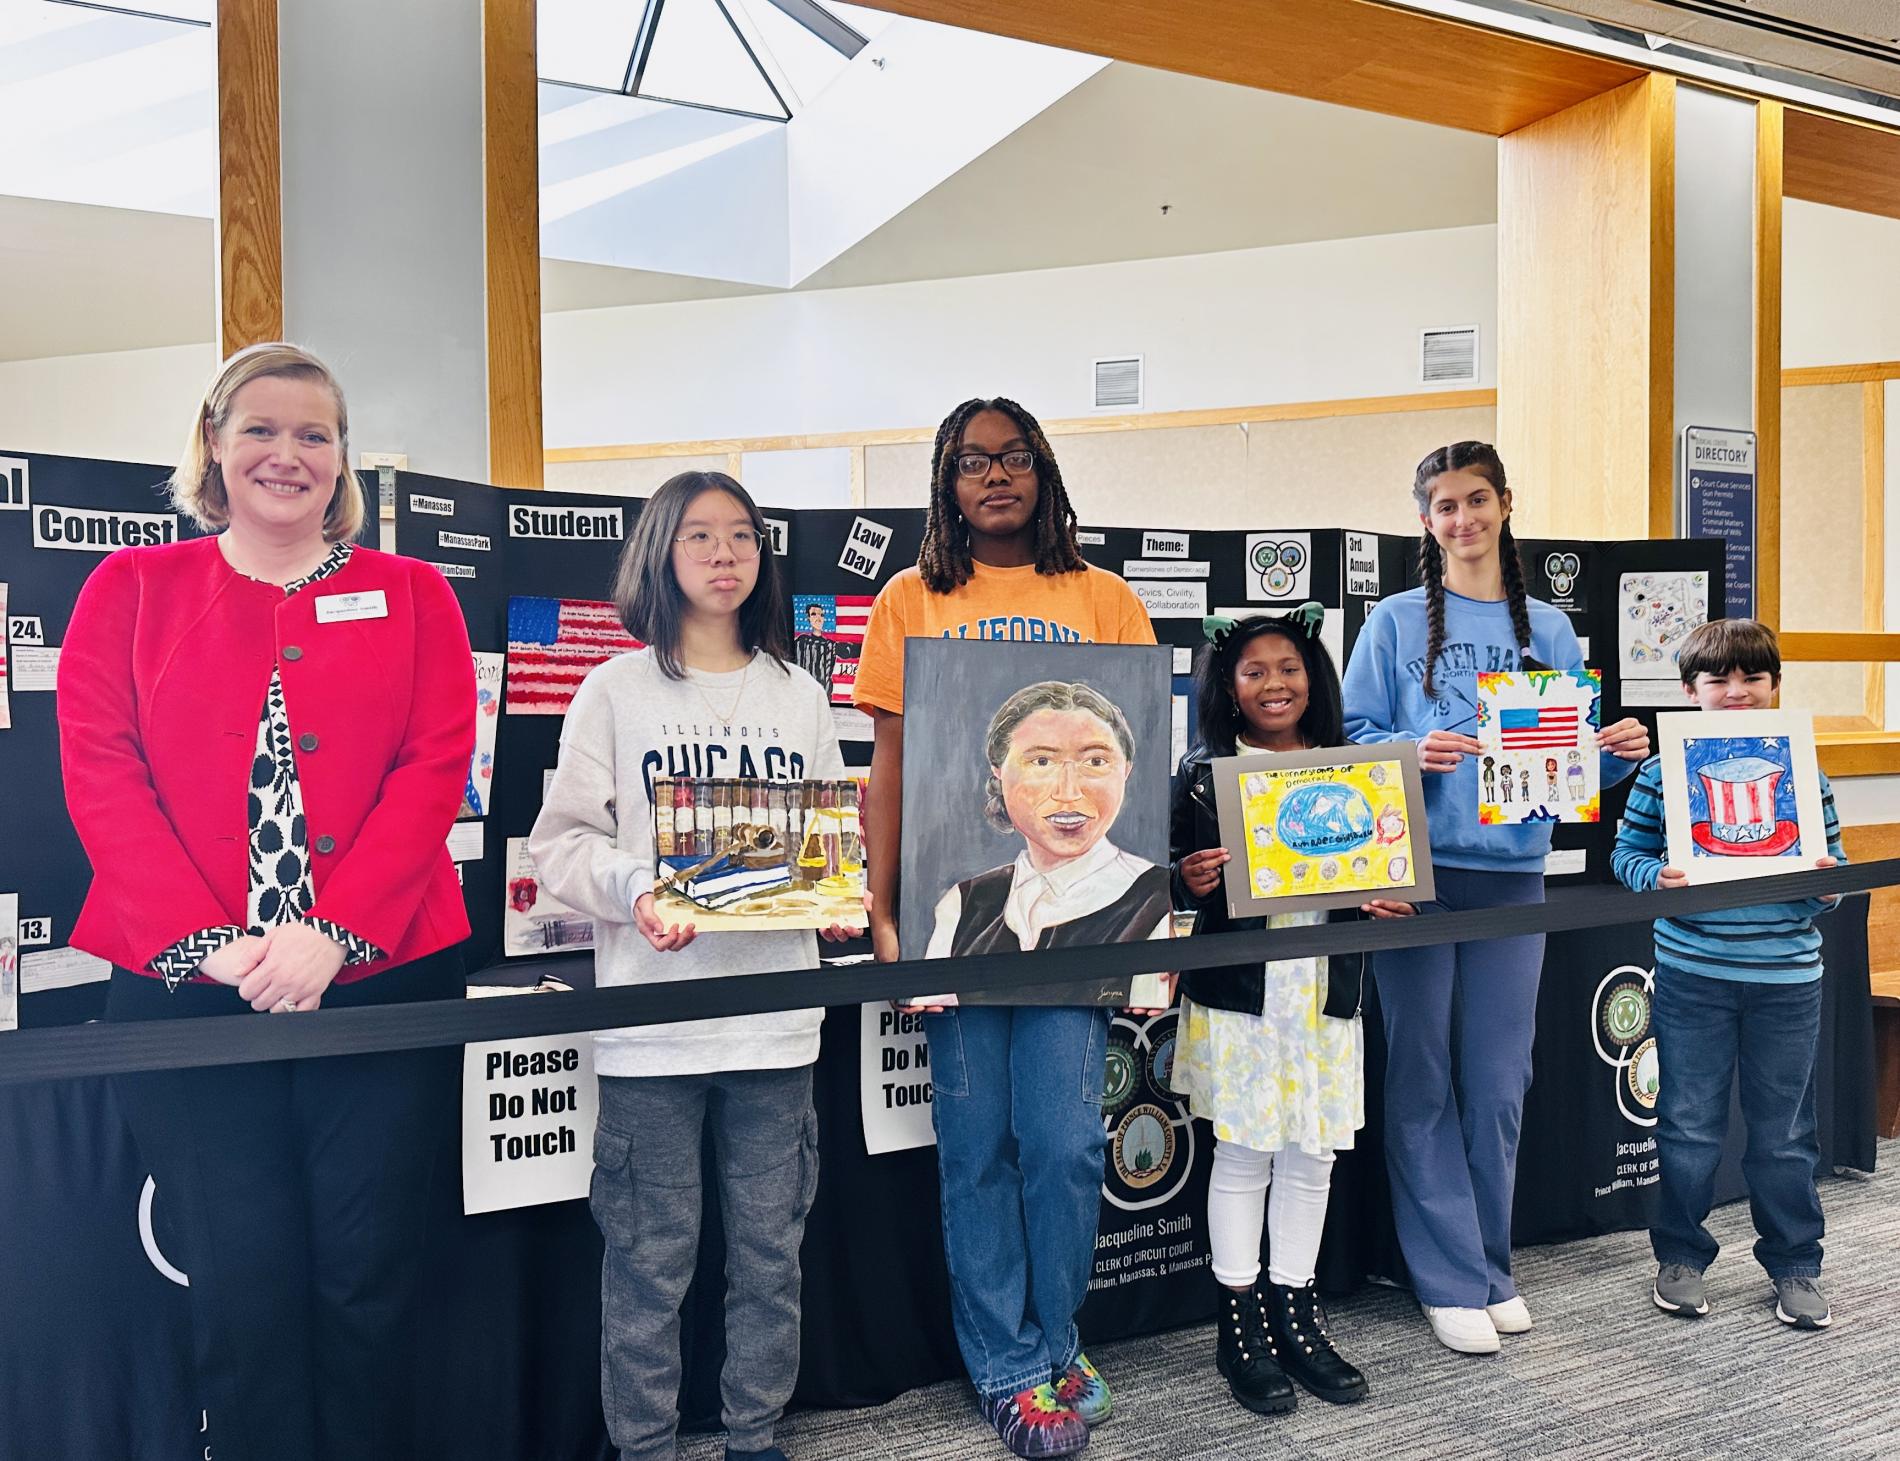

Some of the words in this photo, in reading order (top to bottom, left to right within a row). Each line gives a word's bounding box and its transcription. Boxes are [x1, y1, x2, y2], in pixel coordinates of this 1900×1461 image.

[1696, 446, 1747, 463] DIRECTORY
[412, 498, 452, 513] #Manassas
[39, 508, 174, 546] Contest
[513, 508, 619, 538] Student
[440, 533, 490, 549] #ManassasPark
[852, 522, 886, 549] Law
[1146, 538, 1184, 552] Theme:
[1349, 537, 1362, 552] 3rd
[843, 547, 876, 576] Day
[1350, 558, 1375, 573] Annual
[1138, 588, 1164, 597] Civics,
[1167, 588, 1195, 599] Civility,
[1350, 578, 1364, 592] Law
[1365, 579, 1378, 594] Day
[1146, 600, 1200, 609] Collaboration
[12, 620, 41, 638] 24.
[1405, 642, 1478, 683] OTER
[661, 724, 779, 738] ILLINOIS
[21, 920, 47, 939] 13.
[880, 1011, 925, 1036] Plea
[486, 1048, 579, 1080] Please
[882, 1047, 909, 1072] Do
[489, 1093, 525, 1121] Do
[532, 1086, 577, 1116] Not
[882, 1082, 934, 1109] Touc
[1121, 1107, 1141, 1130] PRINCE
[1143, 1106, 1169, 1128] WILLIAM
[490, 1126, 576, 1162] Touch
[1617, 1163, 1638, 1175] CLERK
[1640, 1161, 1648, 1172] OF
[1094, 1223, 1154, 1250] Jacqueline
[1158, 1213, 1192, 1235] Smith
[1096, 1257, 1122, 1273] CLERK
[1123, 1255, 1132, 1267] OF
[1134, 1247, 1167, 1263] CIRCUIT
[1169, 1240, 1193, 1257] COURT
[1119, 1267, 1158, 1284] Manassas,
[1160, 1264, 1167, 1275] &
[1169, 1257, 1203, 1273] Manassas
